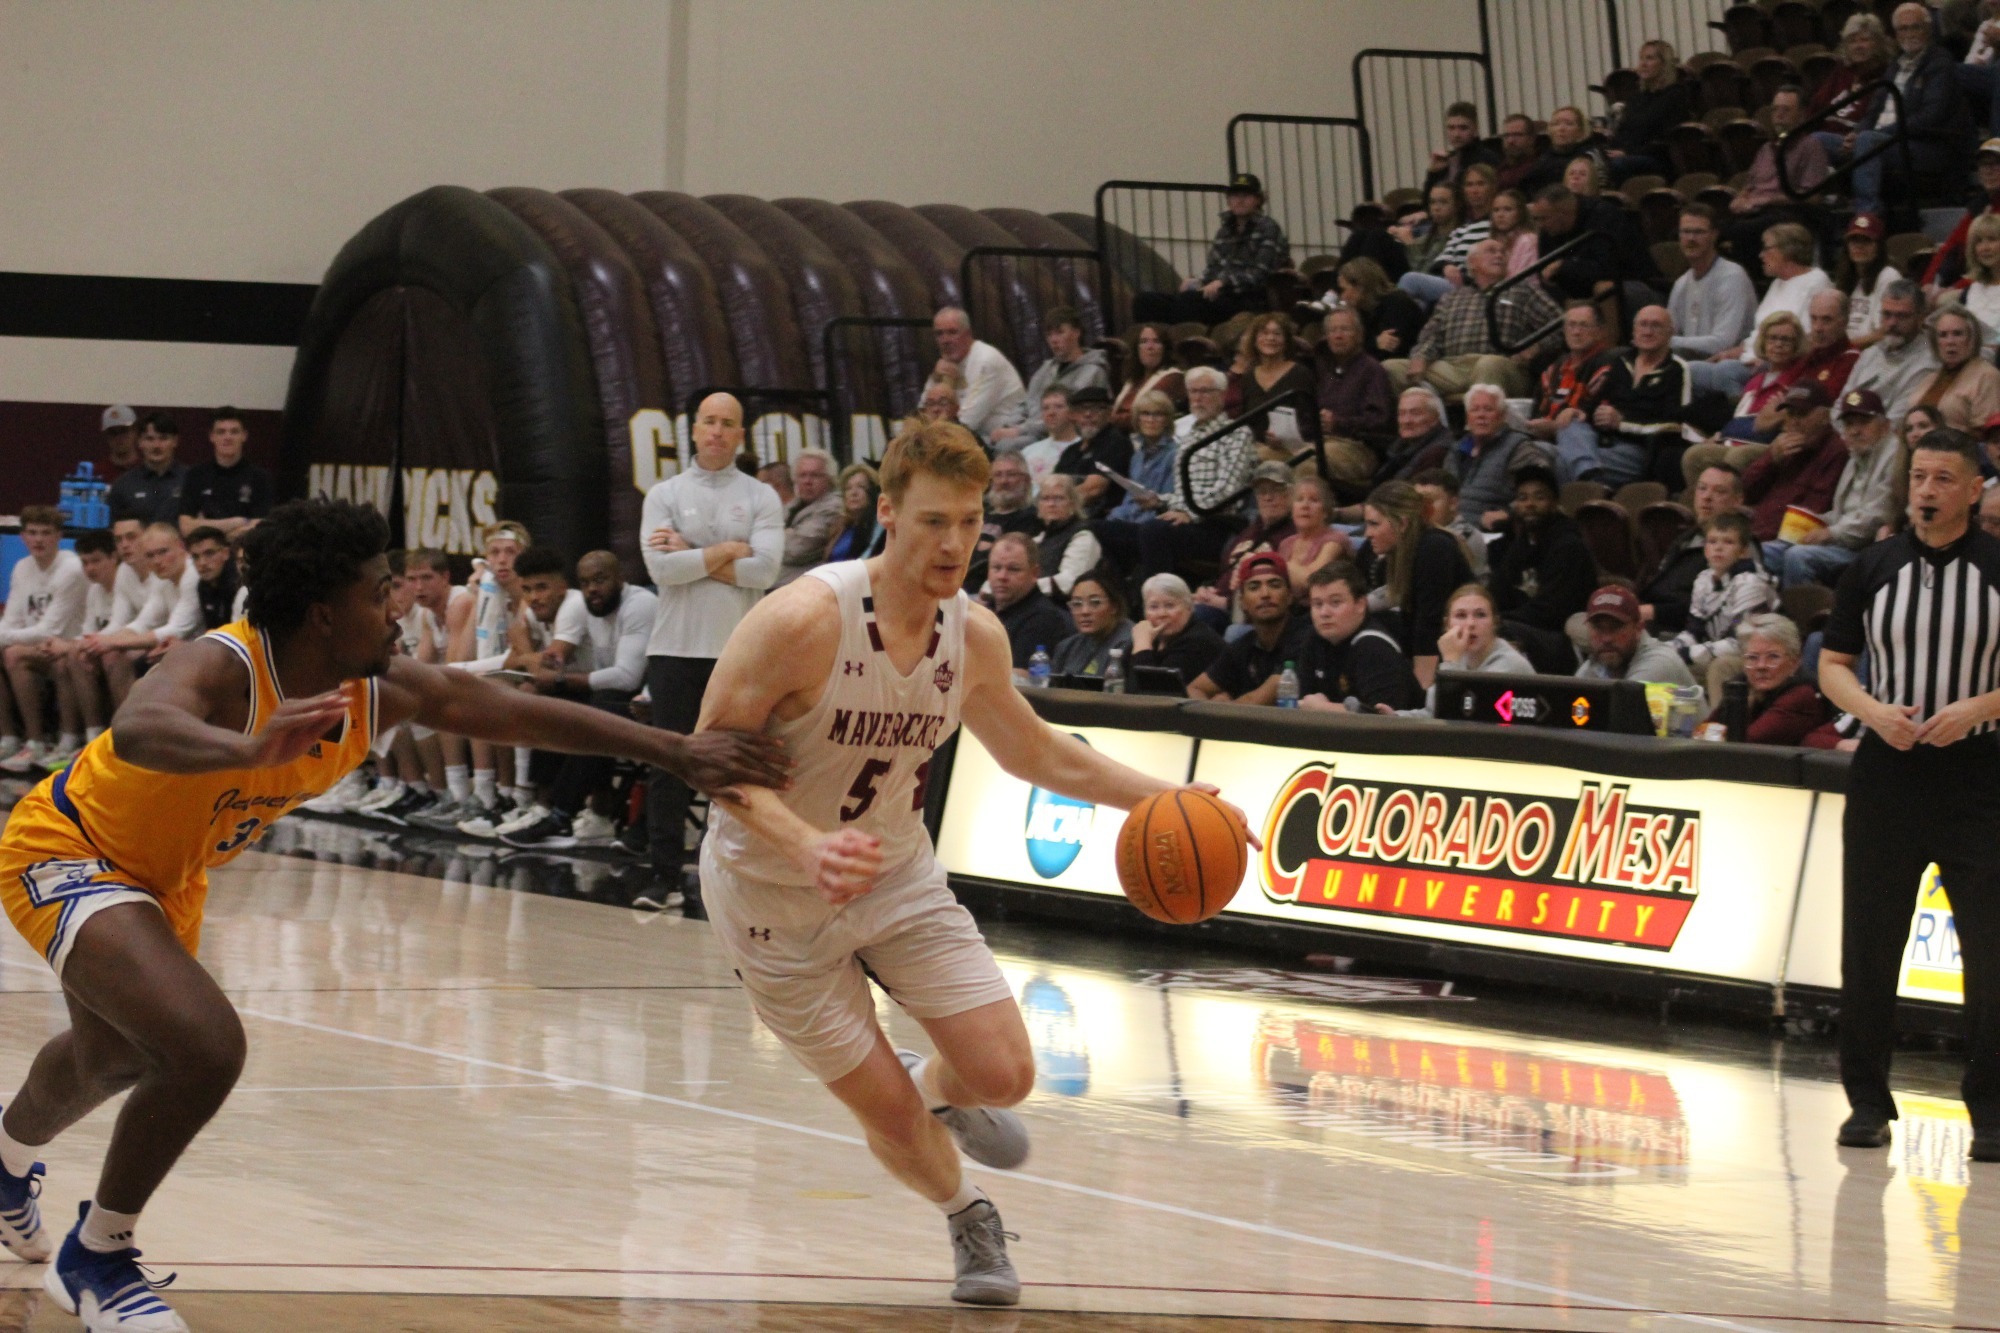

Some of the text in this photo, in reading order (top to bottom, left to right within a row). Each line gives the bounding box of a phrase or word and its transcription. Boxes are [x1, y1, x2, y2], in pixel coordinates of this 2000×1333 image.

[1025, 801, 1095, 845] NCAA
[1258, 763, 1700, 902] COLORADO MESA
[1322, 867, 1656, 939] UNIVERSITY
